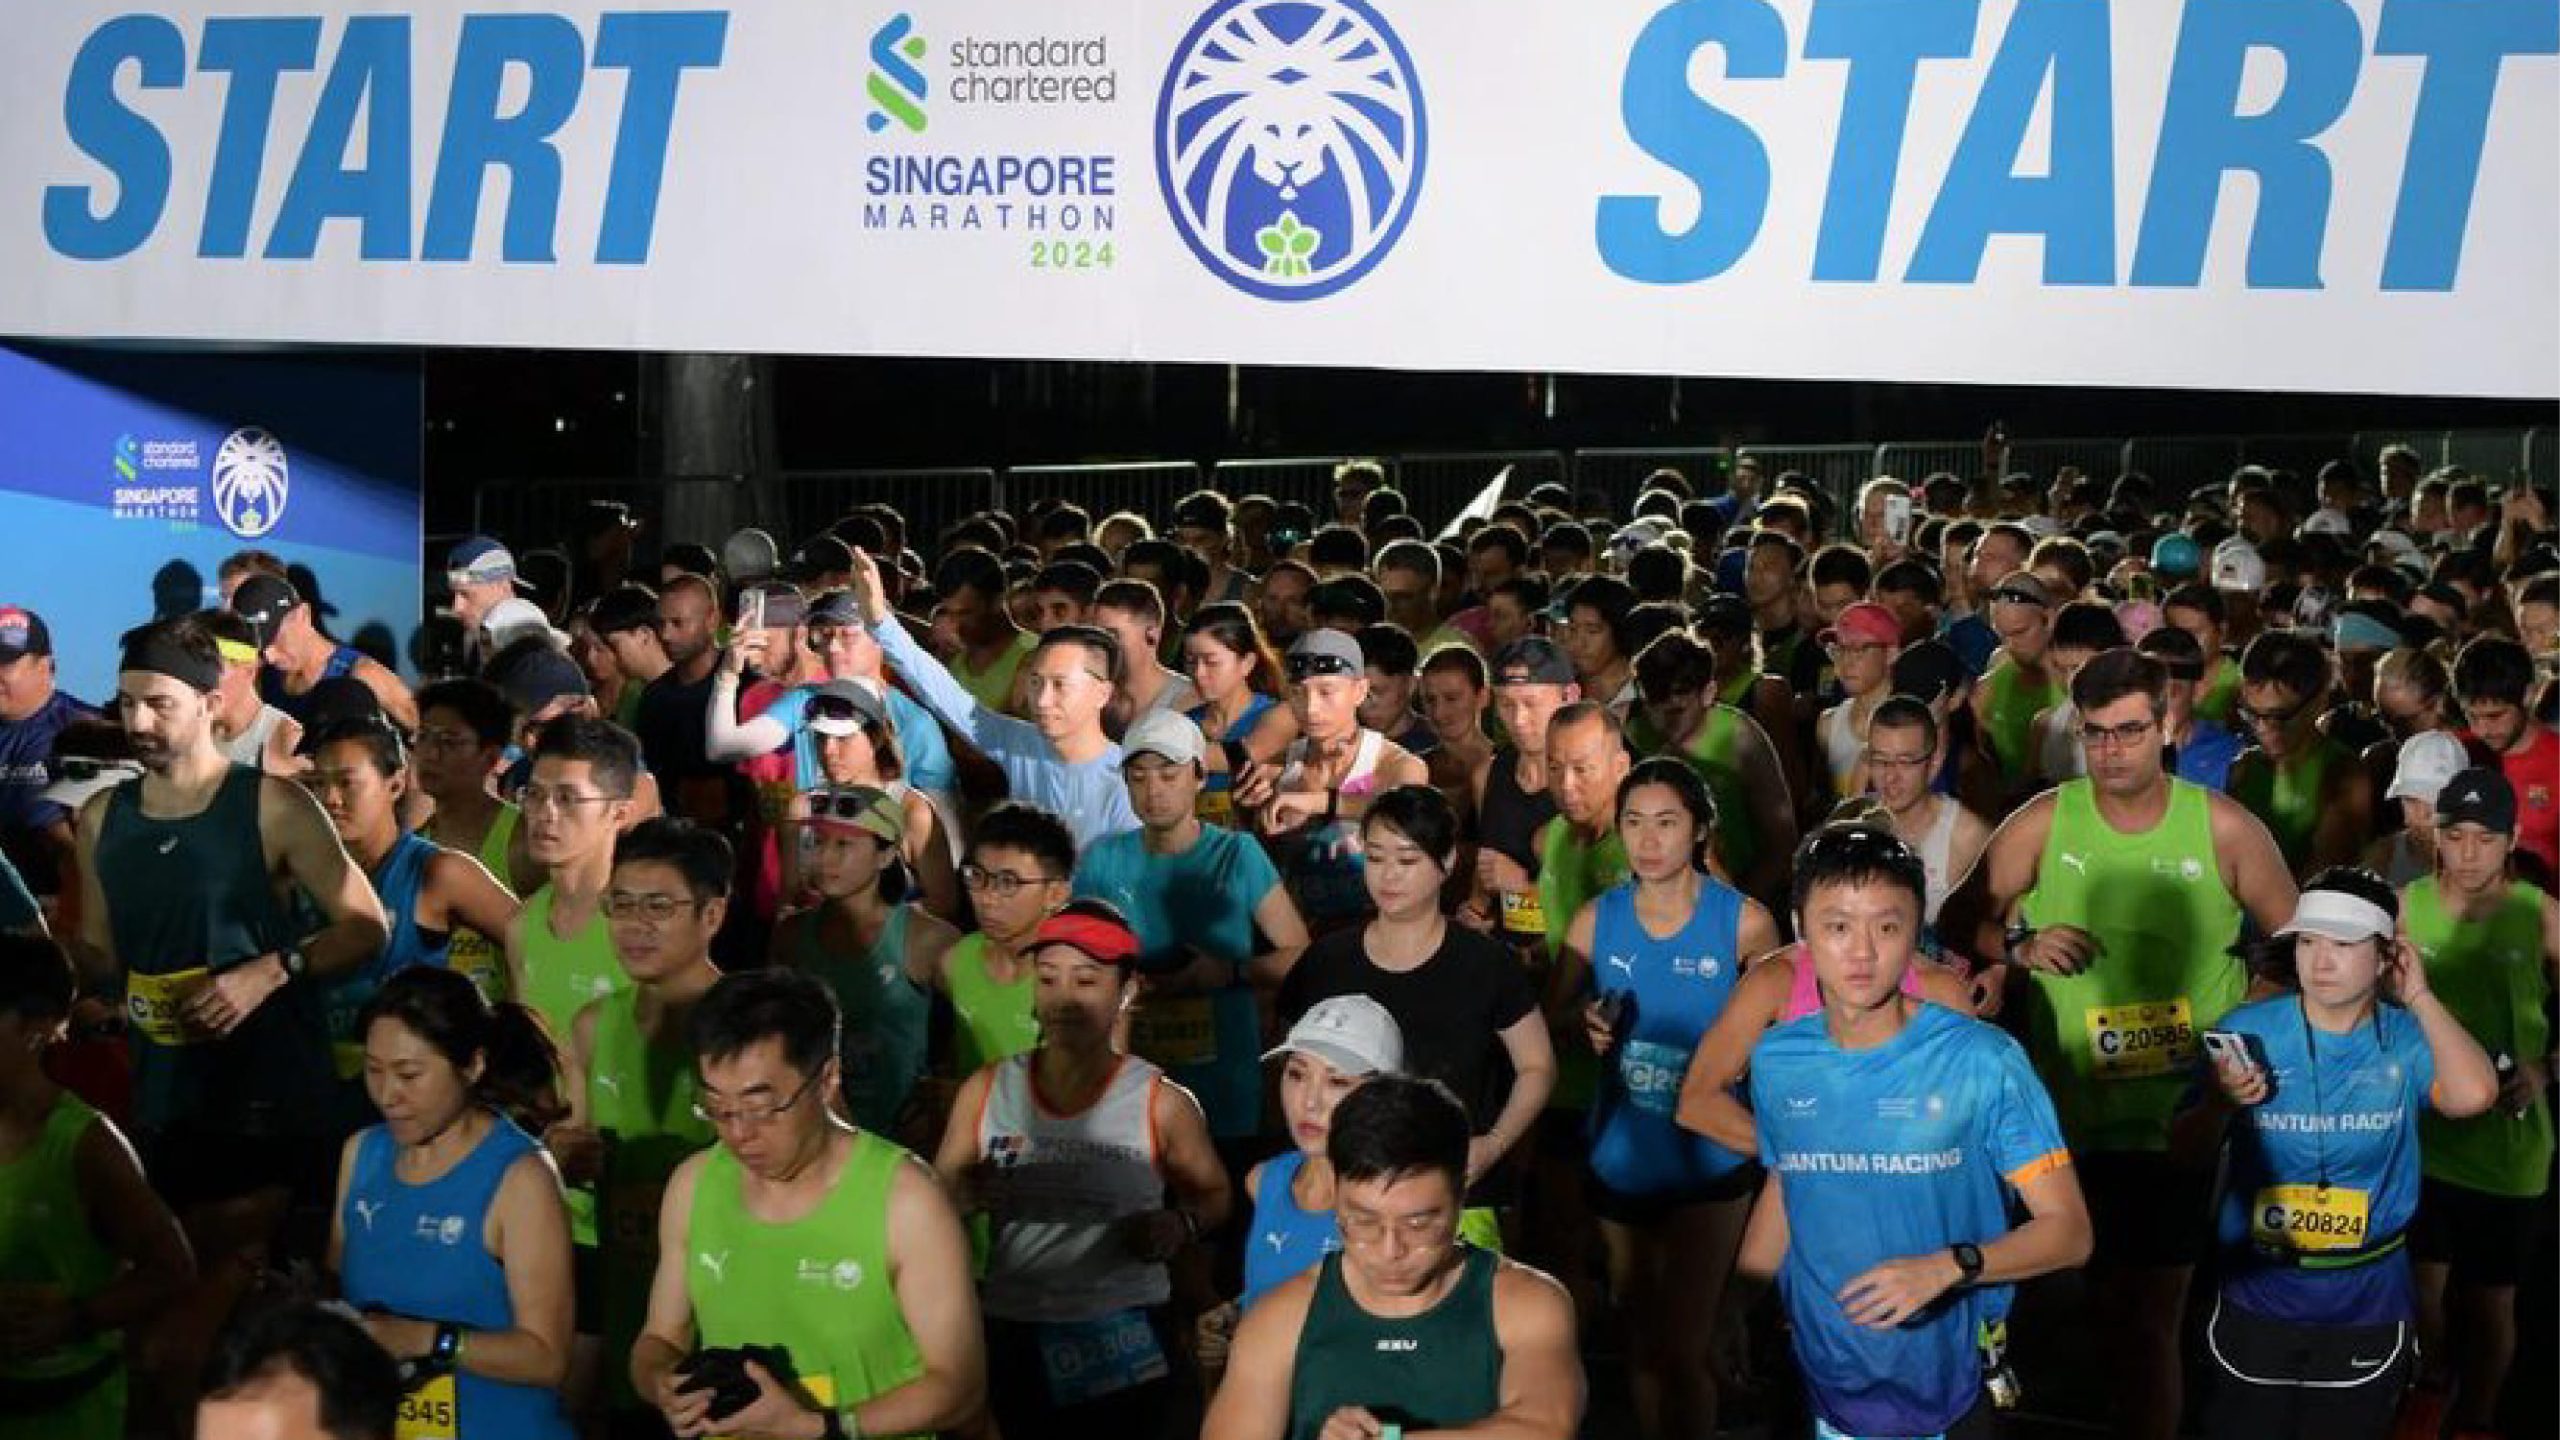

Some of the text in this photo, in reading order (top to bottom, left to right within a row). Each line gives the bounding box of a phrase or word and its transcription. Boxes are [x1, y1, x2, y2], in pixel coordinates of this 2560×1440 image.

[950, 36, 1106, 68] standard
[950, 70, 1117, 103] chartered
[42, 10, 729, 265] START
[1595, 0, 2560, 293] START
[865, 156, 1116, 196] SINGAPORE
[863, 203, 1115, 231] MARATHON
[1030, 240, 1115, 269] 2024
[2099, 1030, 2118, 1055] C
[1872, 1147, 1962, 1174] RACING
[2264, 1206, 2363, 1235] C 20824
